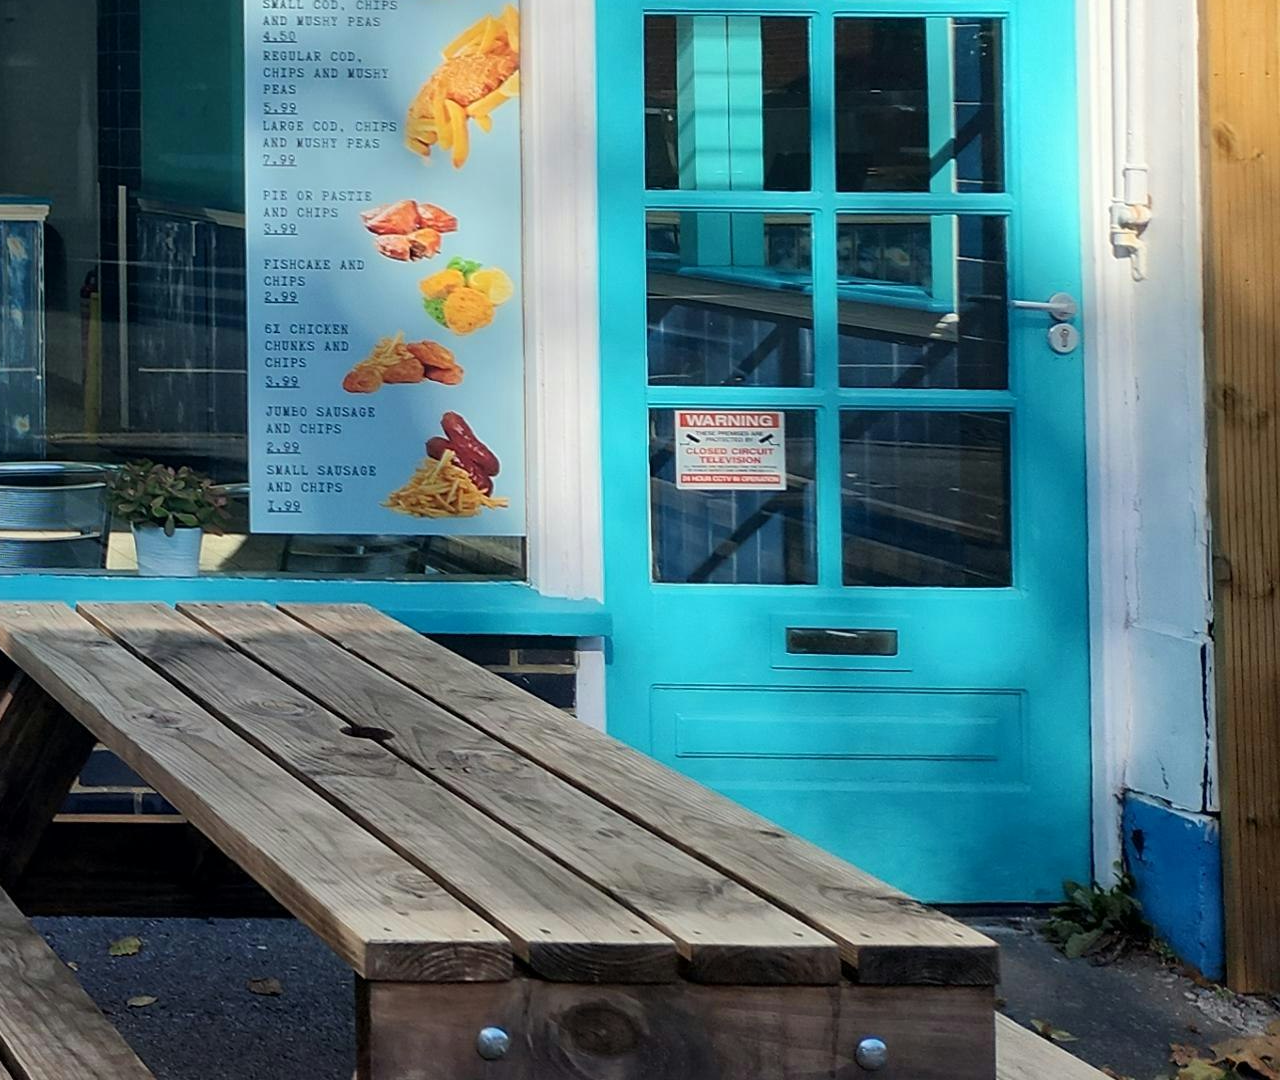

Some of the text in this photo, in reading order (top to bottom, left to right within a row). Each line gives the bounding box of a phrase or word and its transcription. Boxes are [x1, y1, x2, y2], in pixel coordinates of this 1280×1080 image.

[263, 0, 397, 10] SMALL COD, CHIPS
[263, 16, 380, 27] AND MUSHY PEAS
[263, 31, 297, 43] 4.50
[264, 51, 361, 61] REGULAR COD,
[264, 68, 388, 78] CHIPS AND MUSHY
[264, 84, 296, 94] PEAS
[264, 102, 298, 115] 5.99
[263, 120, 397, 132] LARGE COD, CHIPS
[263, 137, 379, 148] AND MUSHY PEAS
[263, 154, 297, 167] 7.99
[264, 190, 371, 201] PIE OR PASTIE
[264, 207, 338, 217] AND CHIPS
[264, 259, 364, 271] FISHCAKE AND
[264, 276, 305, 286] CHIPS
[264, 292, 299, 303] 2.99
[290, 324, 348, 334] CHICKEN
[265, 341, 348, 351] CHUNKS AND
[265, 358, 306, 367] CHIPS
[265, 376, 300, 388] 3.99
[266, 406, 375, 417] JUMBO SAUSAGE
[686, 415, 773, 426] WARNING
[266, 423, 341, 434] AND CHIPS
[267, 442, 301, 454] 2.99
[267, 465, 376, 476] SMALL SAUSAGE
[268, 482, 343, 492] AND CHIPS
